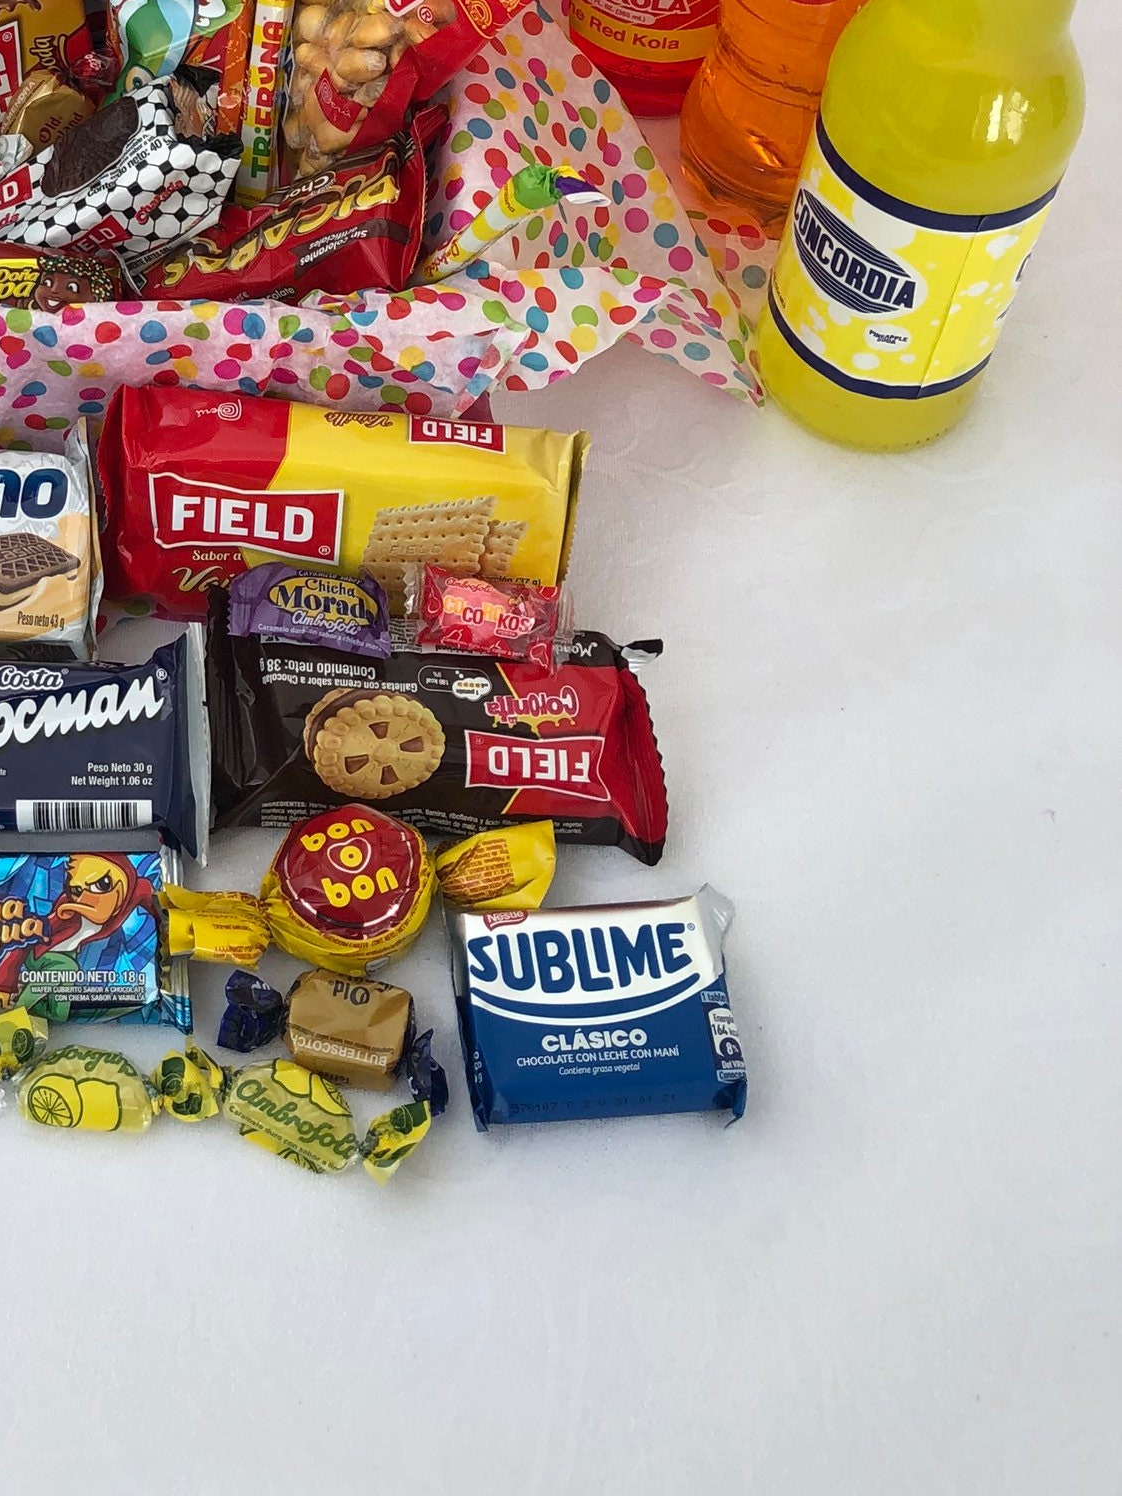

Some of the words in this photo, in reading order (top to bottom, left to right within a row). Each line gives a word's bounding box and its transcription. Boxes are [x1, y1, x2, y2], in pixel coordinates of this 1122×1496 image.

[590, 15, 626, 42] Red
[632, 33, 680, 50] Kola
[354, 229, 368, 238] Sin
[300, 237, 349, 266] colorantes
[794, 188, 916, 310] CONCORDIA
[324, 410, 398, 429] Vainilla
[422, 420, 493, 444] FIELD
[171, 495, 314, 543] FIELD
[192, 549, 229, 562] Sabor
[305, 578, 355, 597] Chicha
[17, 611, 33, 625] Peso
[33, 613, 50, 626] neto
[50, 614, 58, 628] 43
[292, 610, 359, 634] Ambrosoli
[316, 662, 376, 679] Contenido
[87, 762, 109, 774] Peso
[110, 762, 132, 774] Neto
[133, 762, 144, 773] 30
[145, 764, 153, 775] g
[489, 746, 591, 783] FIELD
[71, 776, 87, 786] Net
[88, 775, 119, 788] Weight
[121, 775, 140, 786] 1.06
[142, 778, 153, 786] oz
[300, 818, 375, 853] bon
[321, 867, 399, 908] bon
[468, 923, 692, 994] SUBLIME
[21, 970, 84, 983] CONTENIDO
[86, 971, 119, 983] NETO:
[122, 971, 135, 983] 18
[138, 974, 146, 985] g
[110, 986, 146, 994] CHOCOLATE
[117, 994, 147, 1002] VAINILLA
[332, 982, 371, 1005] Old
[712, 1024, 728, 1035] 164
[542, 1028, 648, 1052] CLÁSICO
[291, 1034, 388, 1067] BUTTERSCOTCH
[517, 1054, 575, 1067] CHOCOLATE
[576, 1053, 597, 1062] CON
[599, 1050, 629, 1061] LECHE
[630, 1049, 652, 1058] CON
[653, 1045, 680, 1057] MANÍ
[559, 1064, 590, 1076] Contiene
[615, 1062, 640, 1075] vegetal
[265, 1127, 282, 1141] duro
